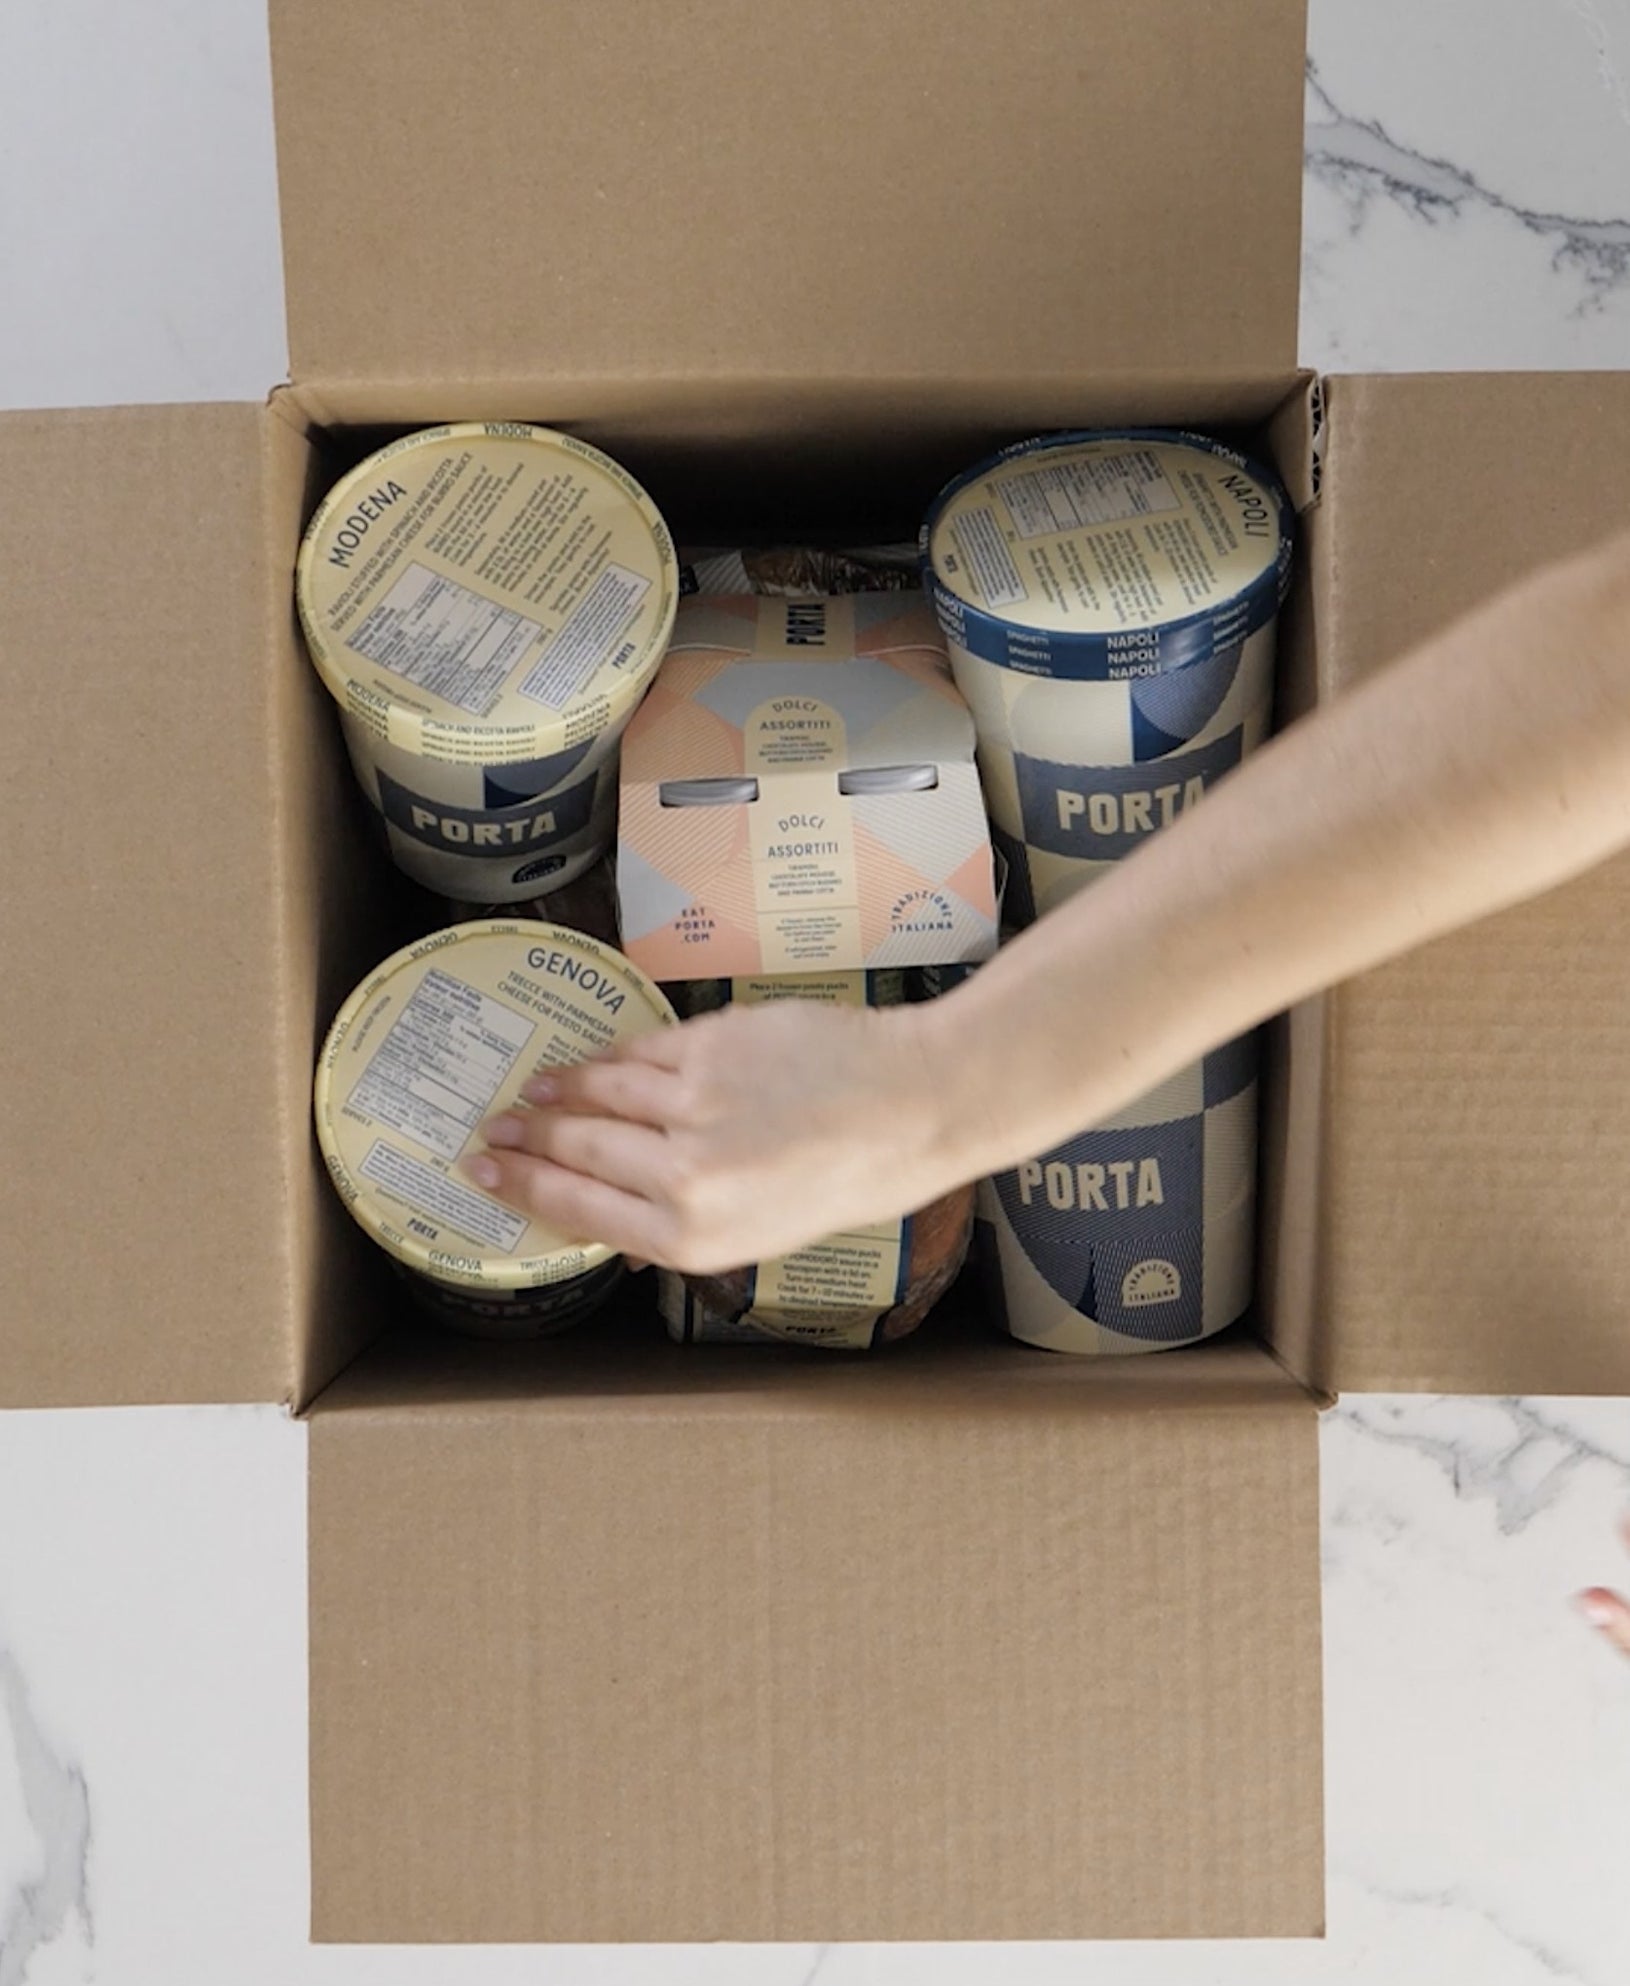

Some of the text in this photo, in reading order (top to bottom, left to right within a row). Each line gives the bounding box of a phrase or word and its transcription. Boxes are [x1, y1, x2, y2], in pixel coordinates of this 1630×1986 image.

[372, 534, 395, 560] WITH
[388, 503, 419, 539] SPINACH
[413, 487, 431, 507] AND
[425, 455, 454, 491] RICOTTA
[1218, 475, 1269, 538] NAPOLI
[329, 480, 407, 568] MODENA
[786, 604, 826, 646] PORTA
[1107, 632, 1159, 649] NAPOLI
[1108, 648, 1160, 664] NAPOLI
[1109, 663, 1161, 680] NAPOLI
[772, 699, 818, 713] DOLCI
[760, 720, 831, 731] ASSORTITI
[1055, 774, 1208, 836] PORTA
[411, 805, 556, 846] PORTA
[779, 814, 824, 832] DOLCI
[768, 842, 838, 858] ASSORTITI
[682, 907, 706, 919] EAT
[890, 889, 953, 921] TRADIZIONE
[675, 919, 715, 932] PORTA
[892, 921, 953, 934] ITALIANA
[527, 947, 626, 1016] GENOVA
[496, 980, 532, 1006] CHEESE
[530, 999, 551, 1017] FOR
[549, 1010, 582, 1035] PESTO
[506, 969, 617, 1039] TRECCE WITH PARMESAN
[1016, 1157, 1164, 1212] PORTA
[408, 1218, 438, 1240] PORTA
[428, 1250, 483, 1271] GENOVA
